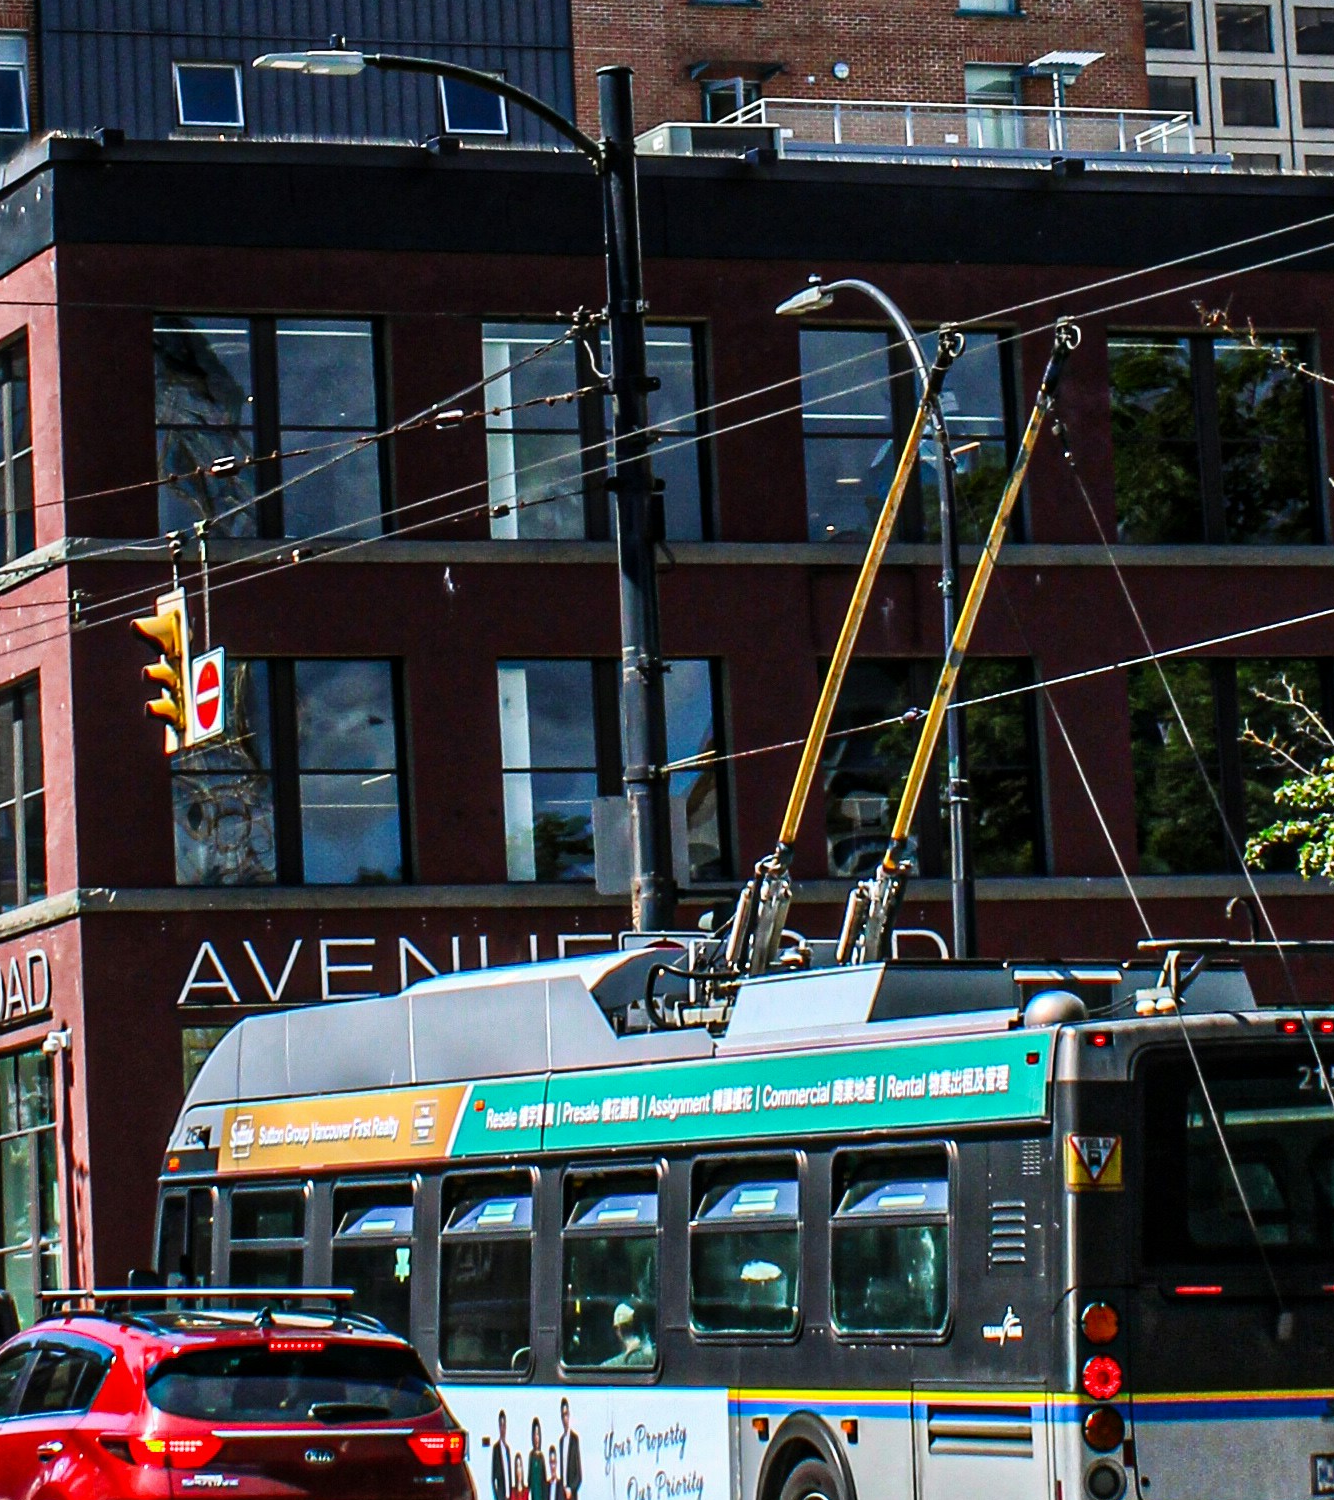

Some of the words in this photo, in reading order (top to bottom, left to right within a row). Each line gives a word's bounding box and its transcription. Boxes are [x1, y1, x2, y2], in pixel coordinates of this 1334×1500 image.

[486, 1107, 517, 1130] Resale
[562, 1100, 599, 1124] Presale
[648, 1093, 711, 1121] Assignment
[763, 1081, 831, 1109] Commercial
[887, 1073, 926, 1099] Rental
[285, 1122, 309, 1149] Group
[311, 1120, 351, 1142] Vancouver
[353, 1117, 372, 1139] First
[603, 1431, 632, 1476] Your
[635, 1422, 687, 1464] Property
